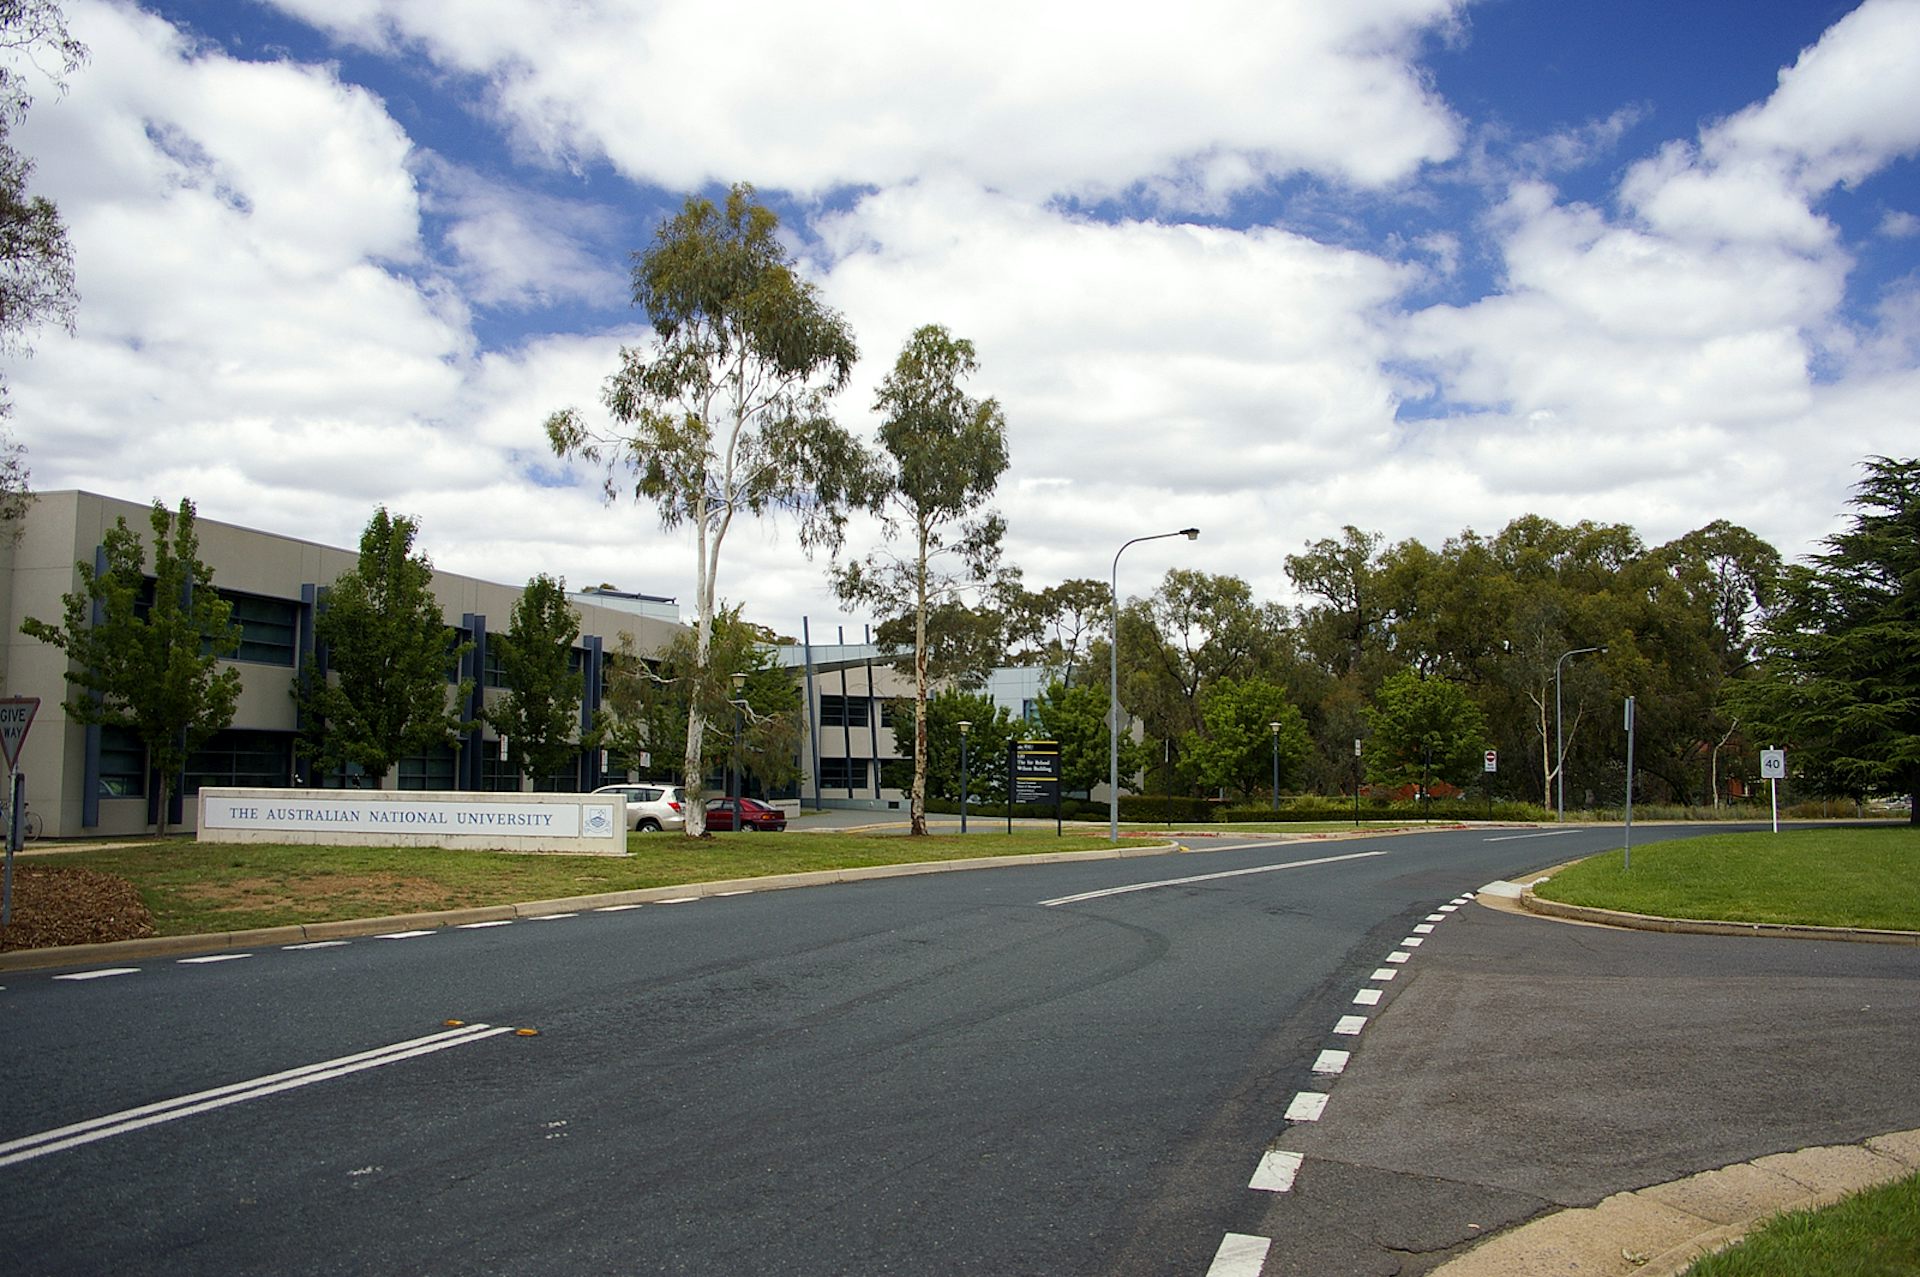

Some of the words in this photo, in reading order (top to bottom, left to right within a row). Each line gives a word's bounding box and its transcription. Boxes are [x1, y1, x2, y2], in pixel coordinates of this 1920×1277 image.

[0, 708, 26, 722] GIVE
[4, 727, 22, 738] WAY
[1765, 760, 1780, 768] 40
[230, 807, 258, 820] THE
[267, 808, 360, 822] AUSTRALIAN
[369, 810, 447, 824] NATIONAL
[457, 812, 553, 826] UNIVERSITY
